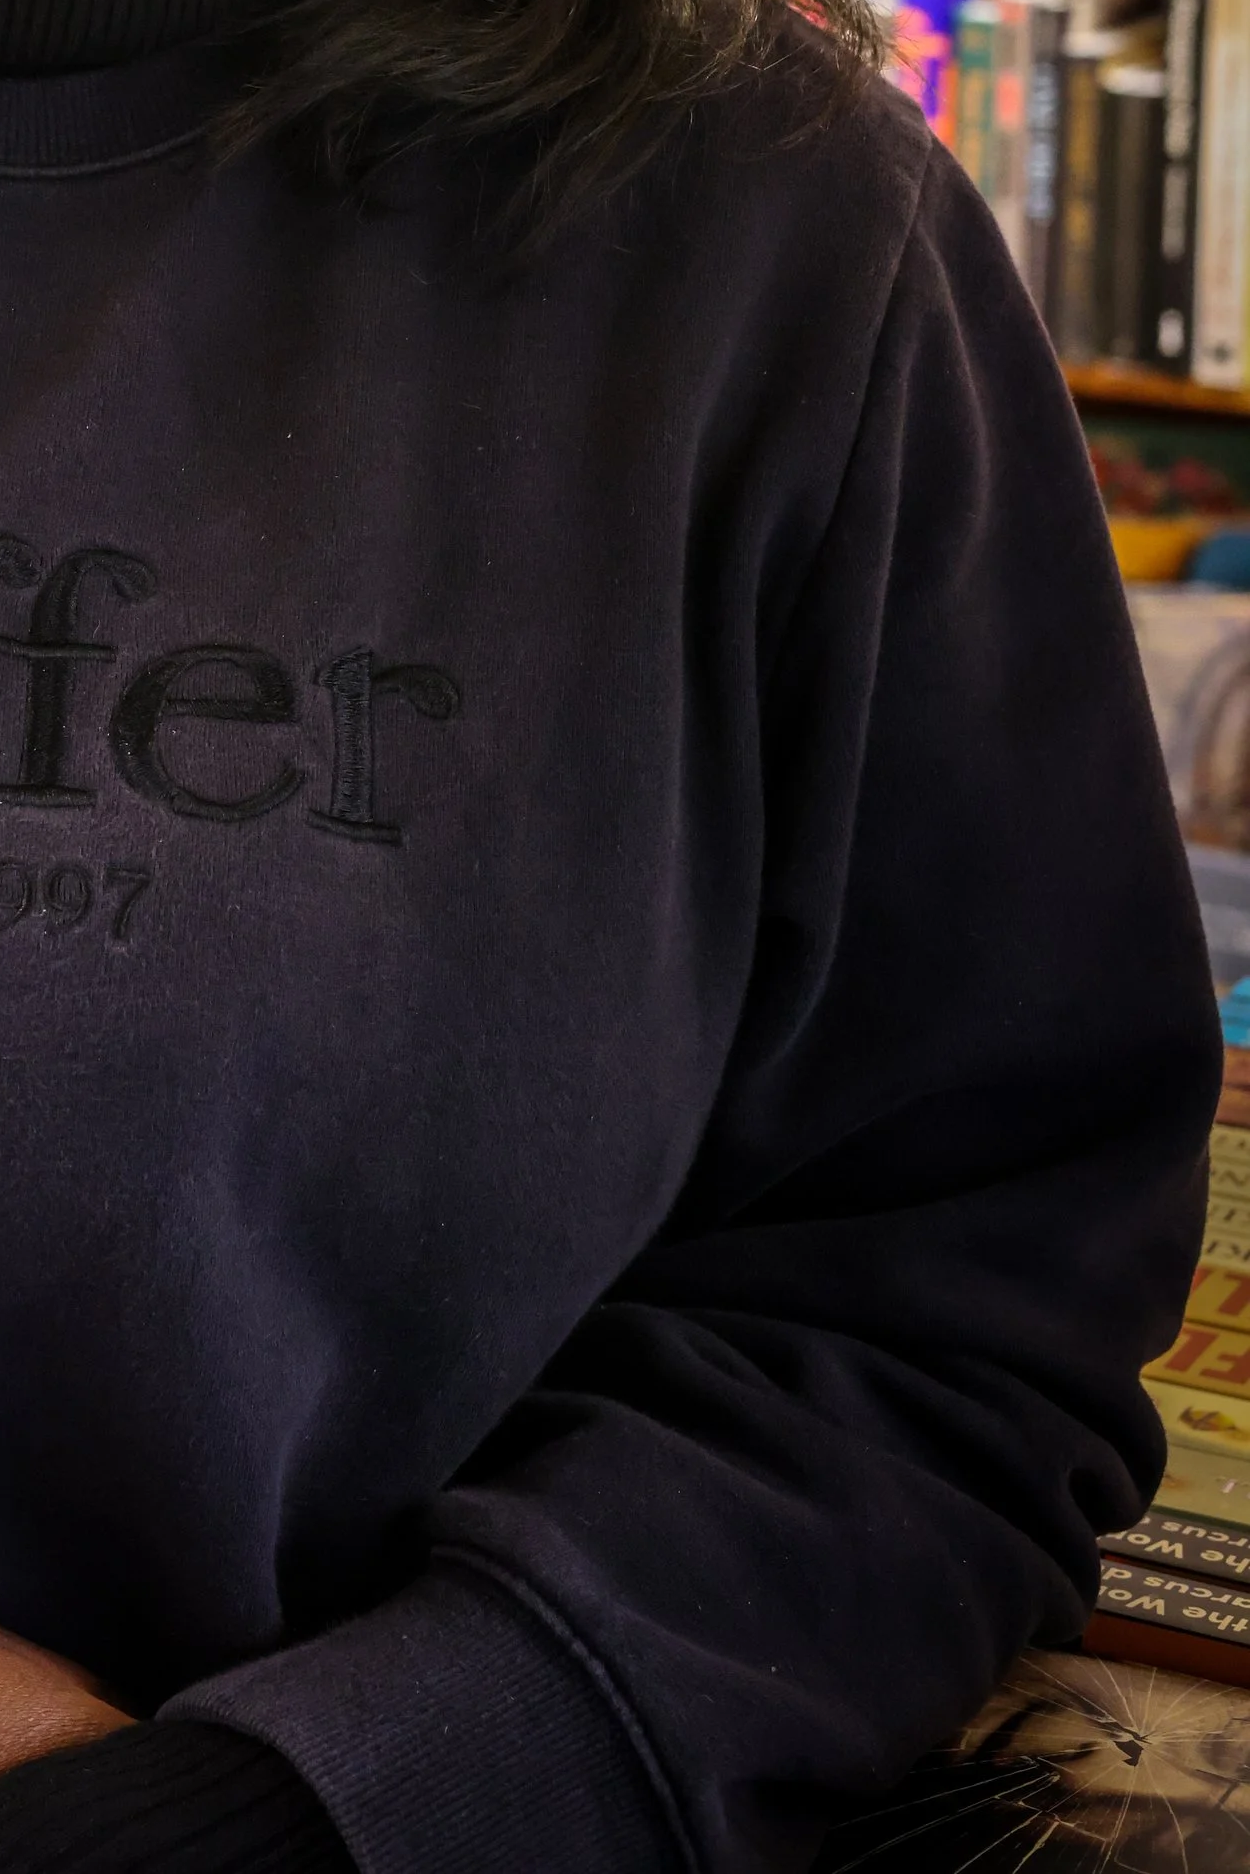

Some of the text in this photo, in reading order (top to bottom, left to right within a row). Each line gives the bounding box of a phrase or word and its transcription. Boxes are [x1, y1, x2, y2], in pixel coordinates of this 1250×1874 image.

[1162, 1522, 1250, 1549] rcus
[1096, 1532, 1250, 1574] he Wor
[1183, 1606, 1249, 1632] the
